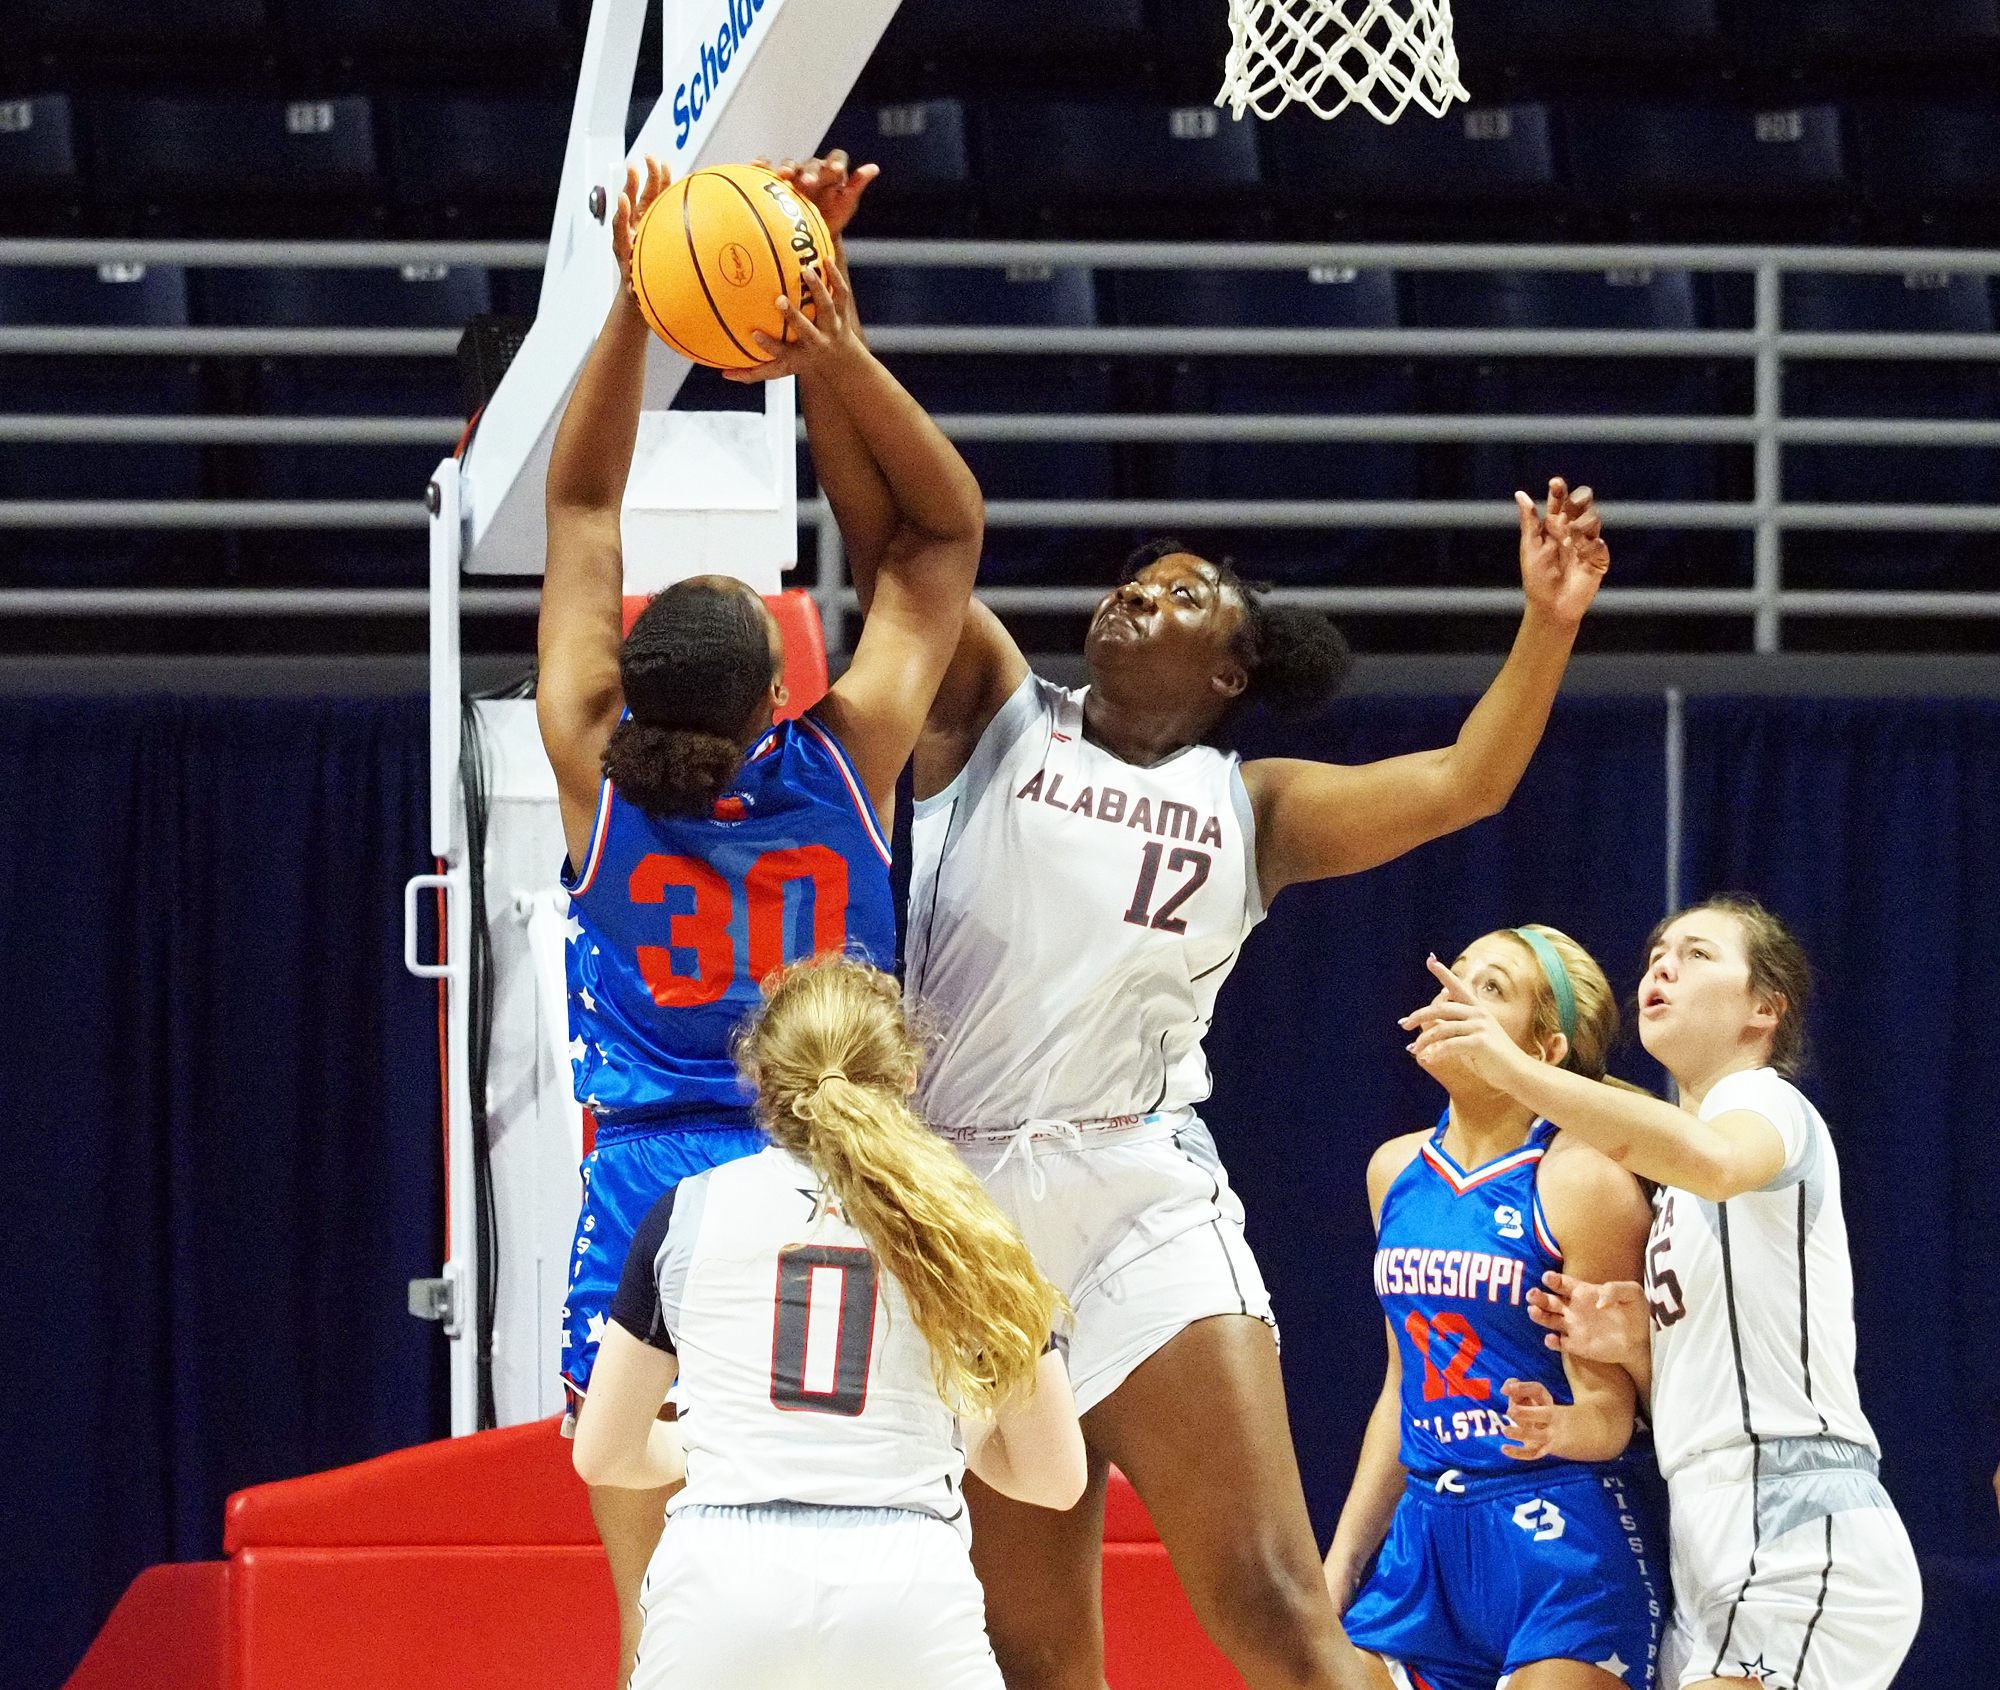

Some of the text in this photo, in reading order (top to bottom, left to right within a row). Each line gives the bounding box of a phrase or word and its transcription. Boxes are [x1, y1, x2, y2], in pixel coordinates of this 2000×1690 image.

[673, 0, 765, 150] Scheld
[1016, 768, 1222, 849] ALABAMA
[629, 844, 849, 1008] 30
[1123, 841, 1211, 935] 12
[1373, 1248, 1525, 1306] MISSISSIPPI
[770, 1243, 879, 1417] 0
[1405, 1310, 1490, 1402] 12
